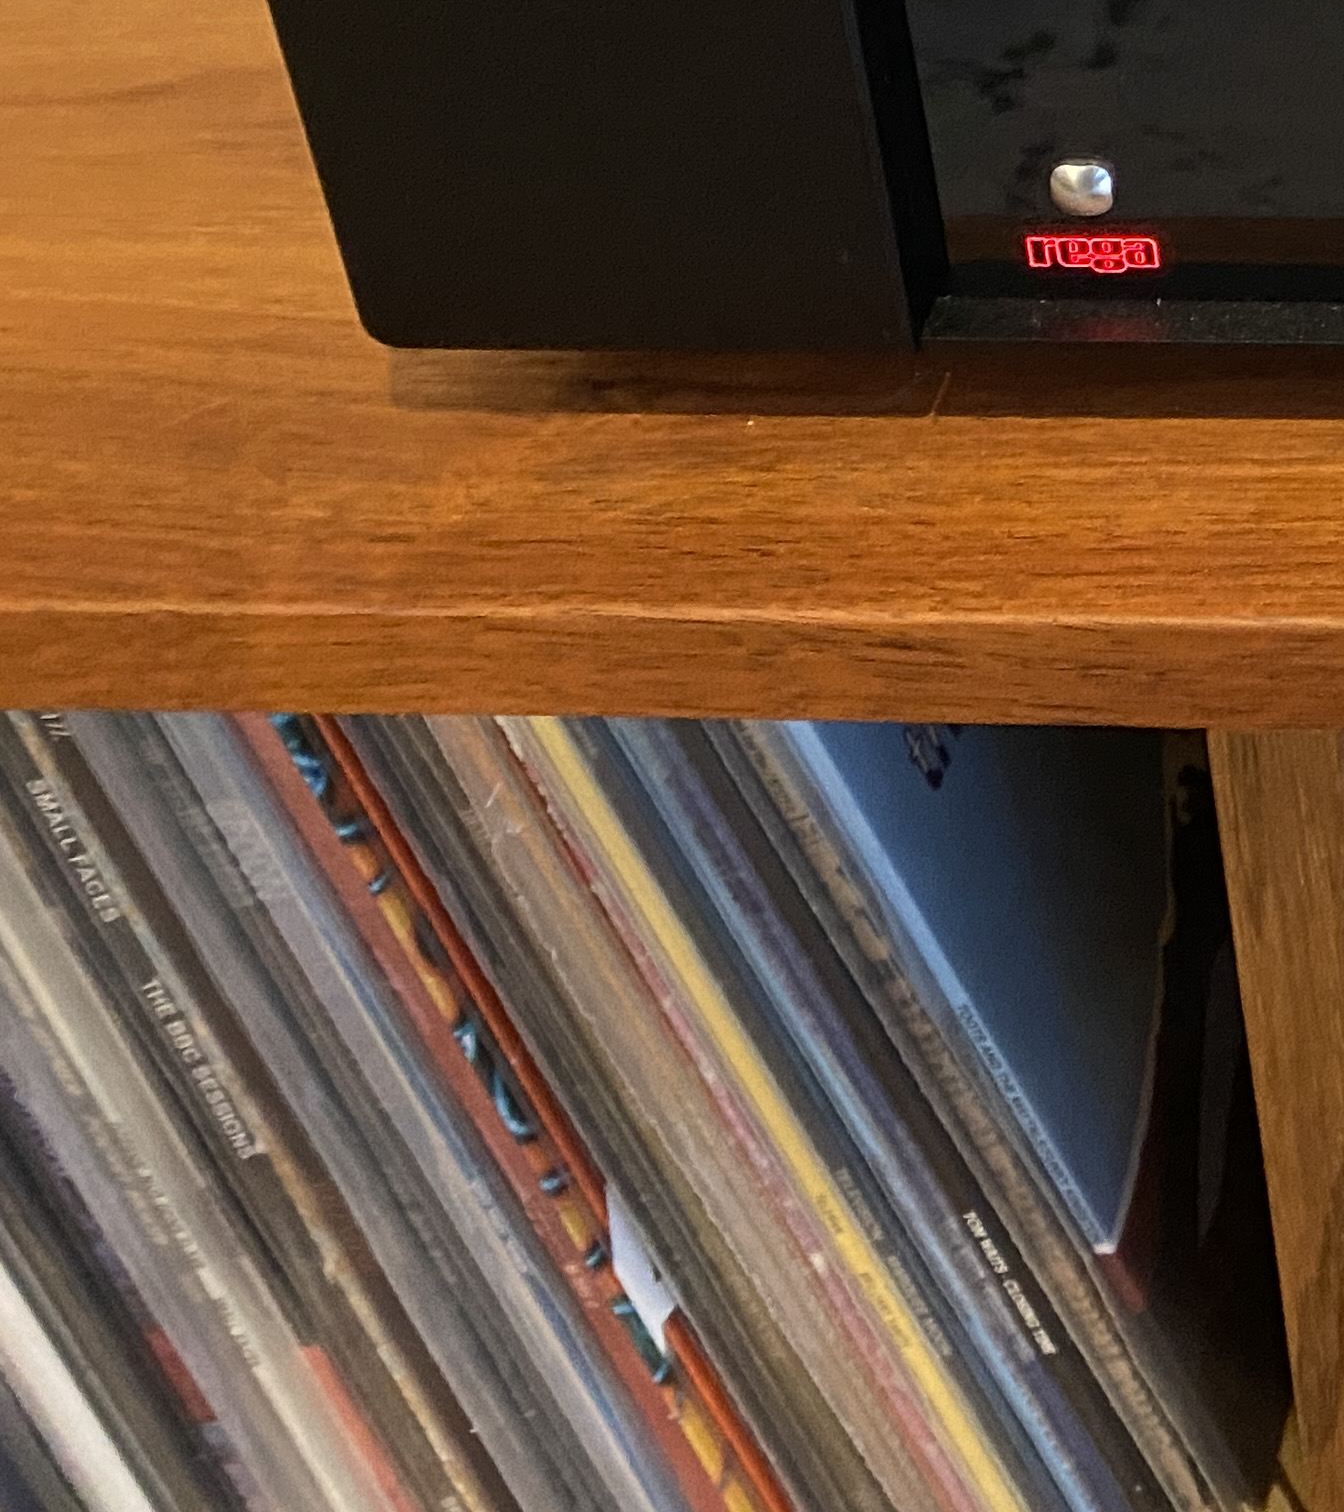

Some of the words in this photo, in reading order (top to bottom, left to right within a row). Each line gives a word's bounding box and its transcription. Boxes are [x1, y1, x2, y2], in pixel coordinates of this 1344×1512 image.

[1026, 236, 1161, 274] rega
[25, 778, 77, 849] SMALL
[69, 852, 122, 924] FACES
[142, 978, 177, 1019] THE
[192, 1065, 259, 1161] SESSIONS
